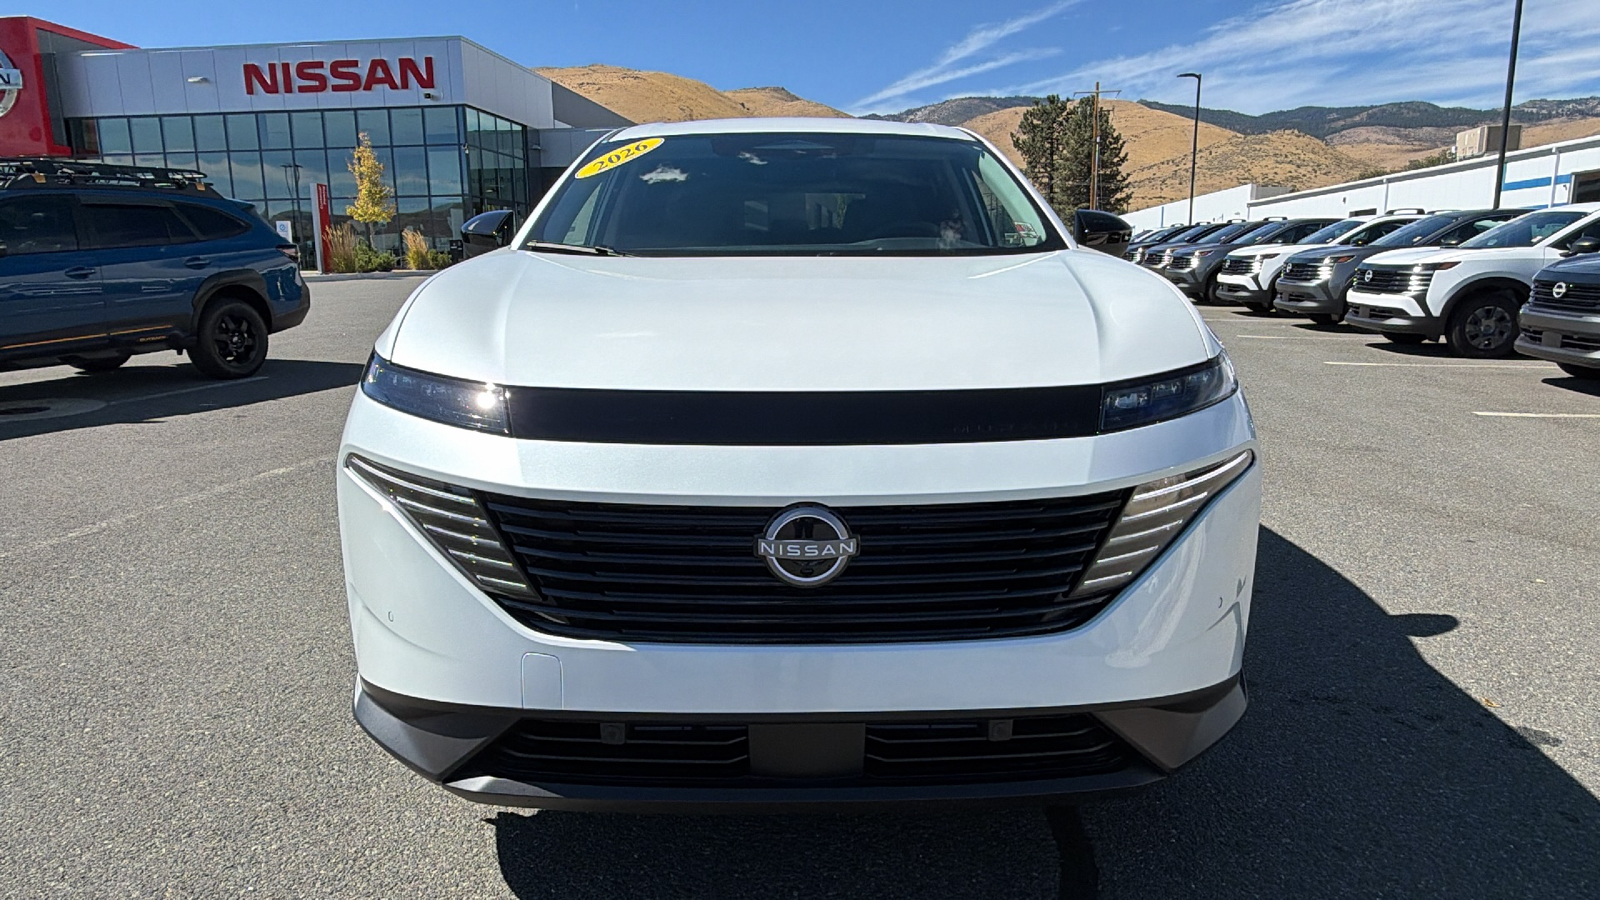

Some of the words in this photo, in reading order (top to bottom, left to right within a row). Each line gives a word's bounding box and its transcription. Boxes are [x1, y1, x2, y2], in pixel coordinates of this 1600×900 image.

[243, 57, 434, 95] NISSAN
[593, 143, 648, 171] 2026
[760, 541, 854, 556] NISSAN
